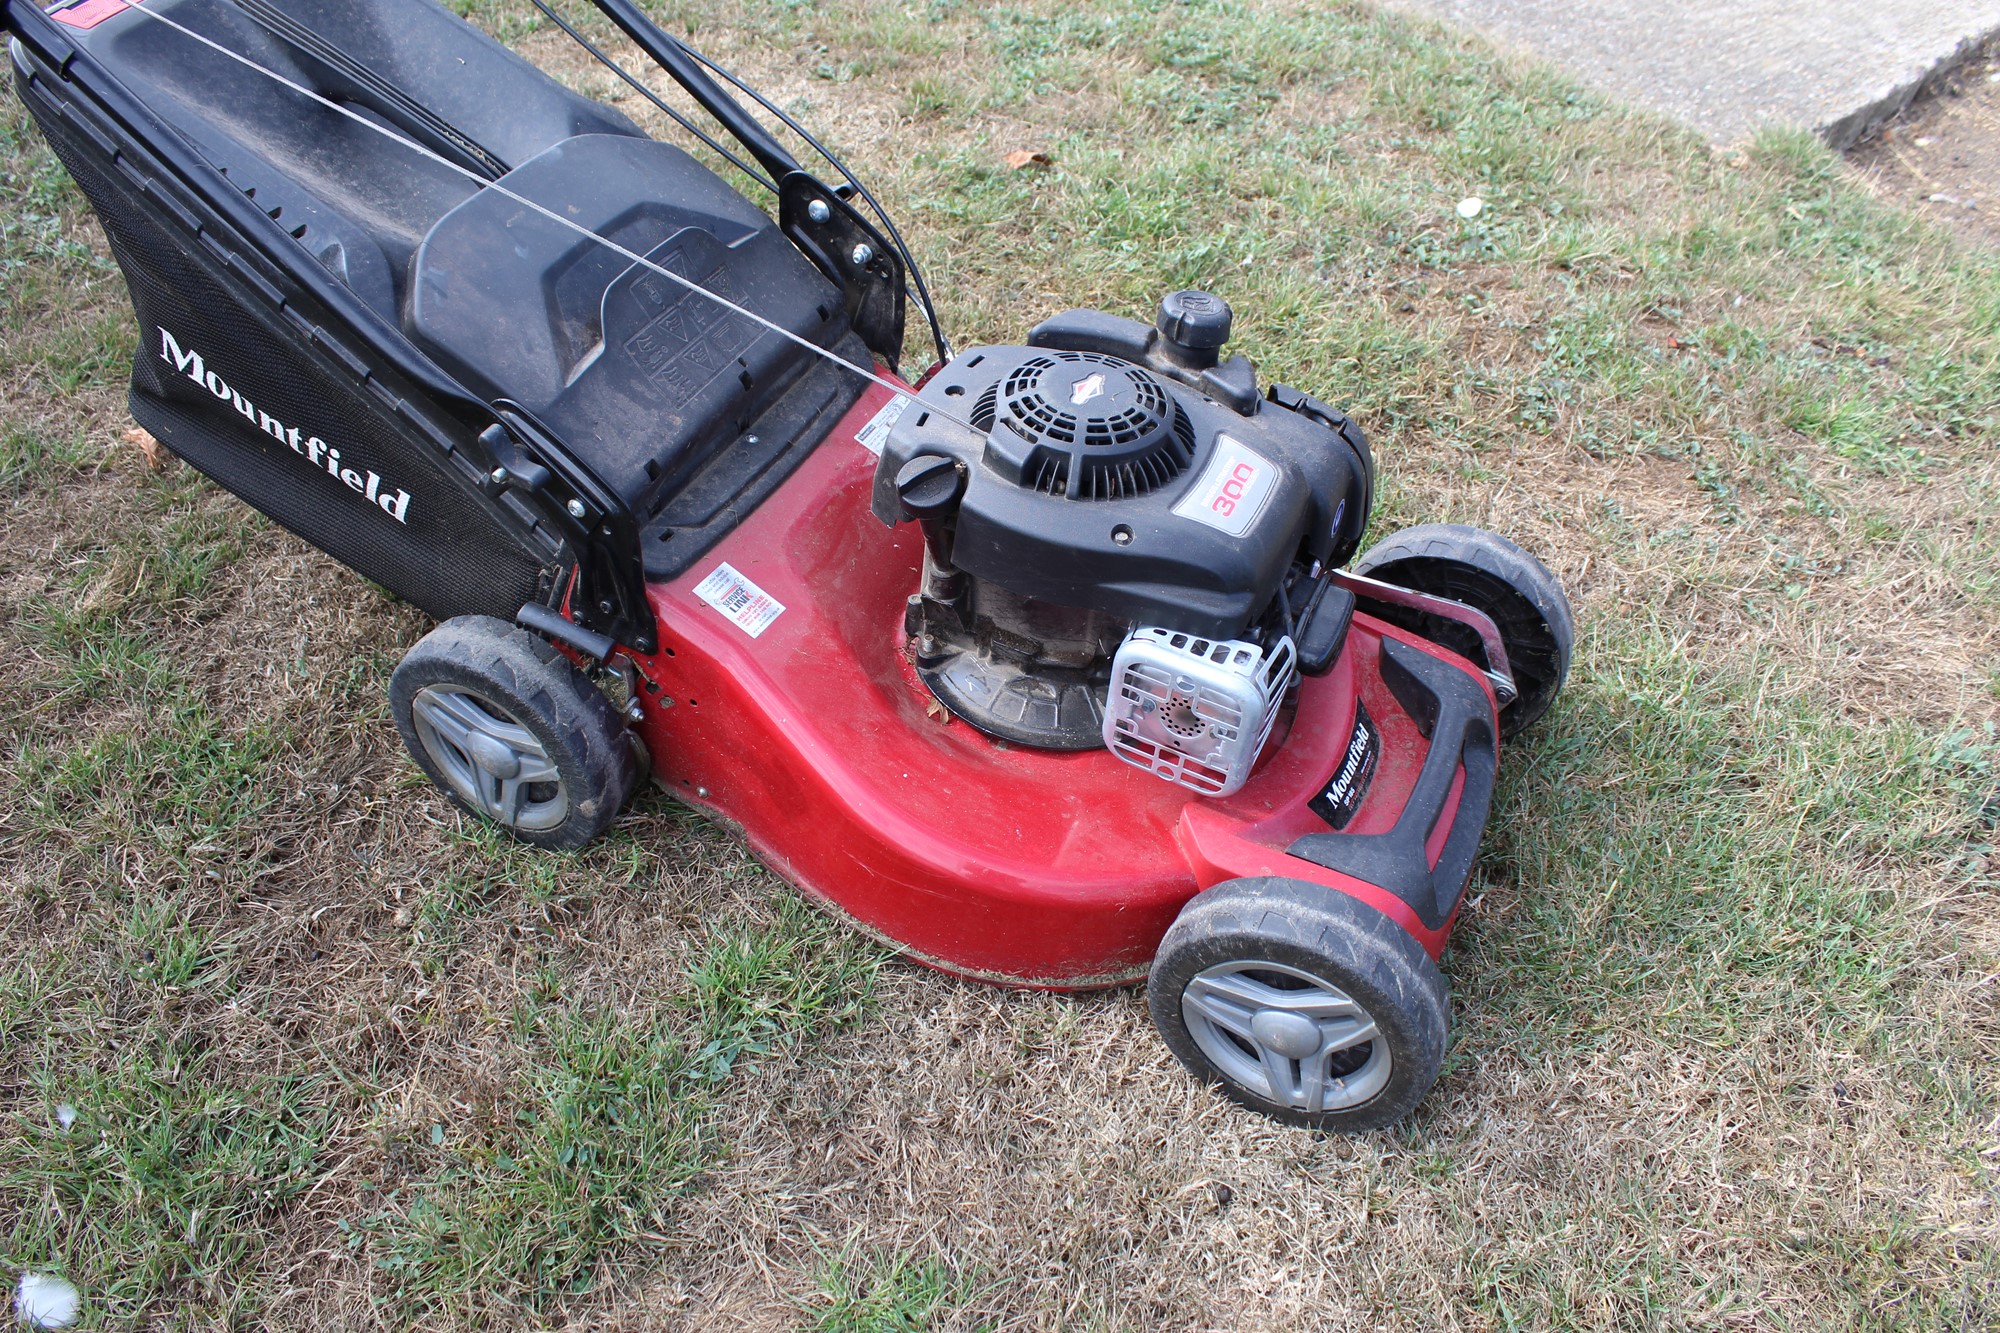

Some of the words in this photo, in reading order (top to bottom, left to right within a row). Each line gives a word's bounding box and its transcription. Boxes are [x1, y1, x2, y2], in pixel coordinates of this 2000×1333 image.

[157, 325, 411, 525] Mountfield
[1212, 463, 1254, 517] 300
[722, 586, 745, 608] SERVICE
[729, 591, 754, 613] LINK
[1326, 722, 1369, 809] Mountfield
